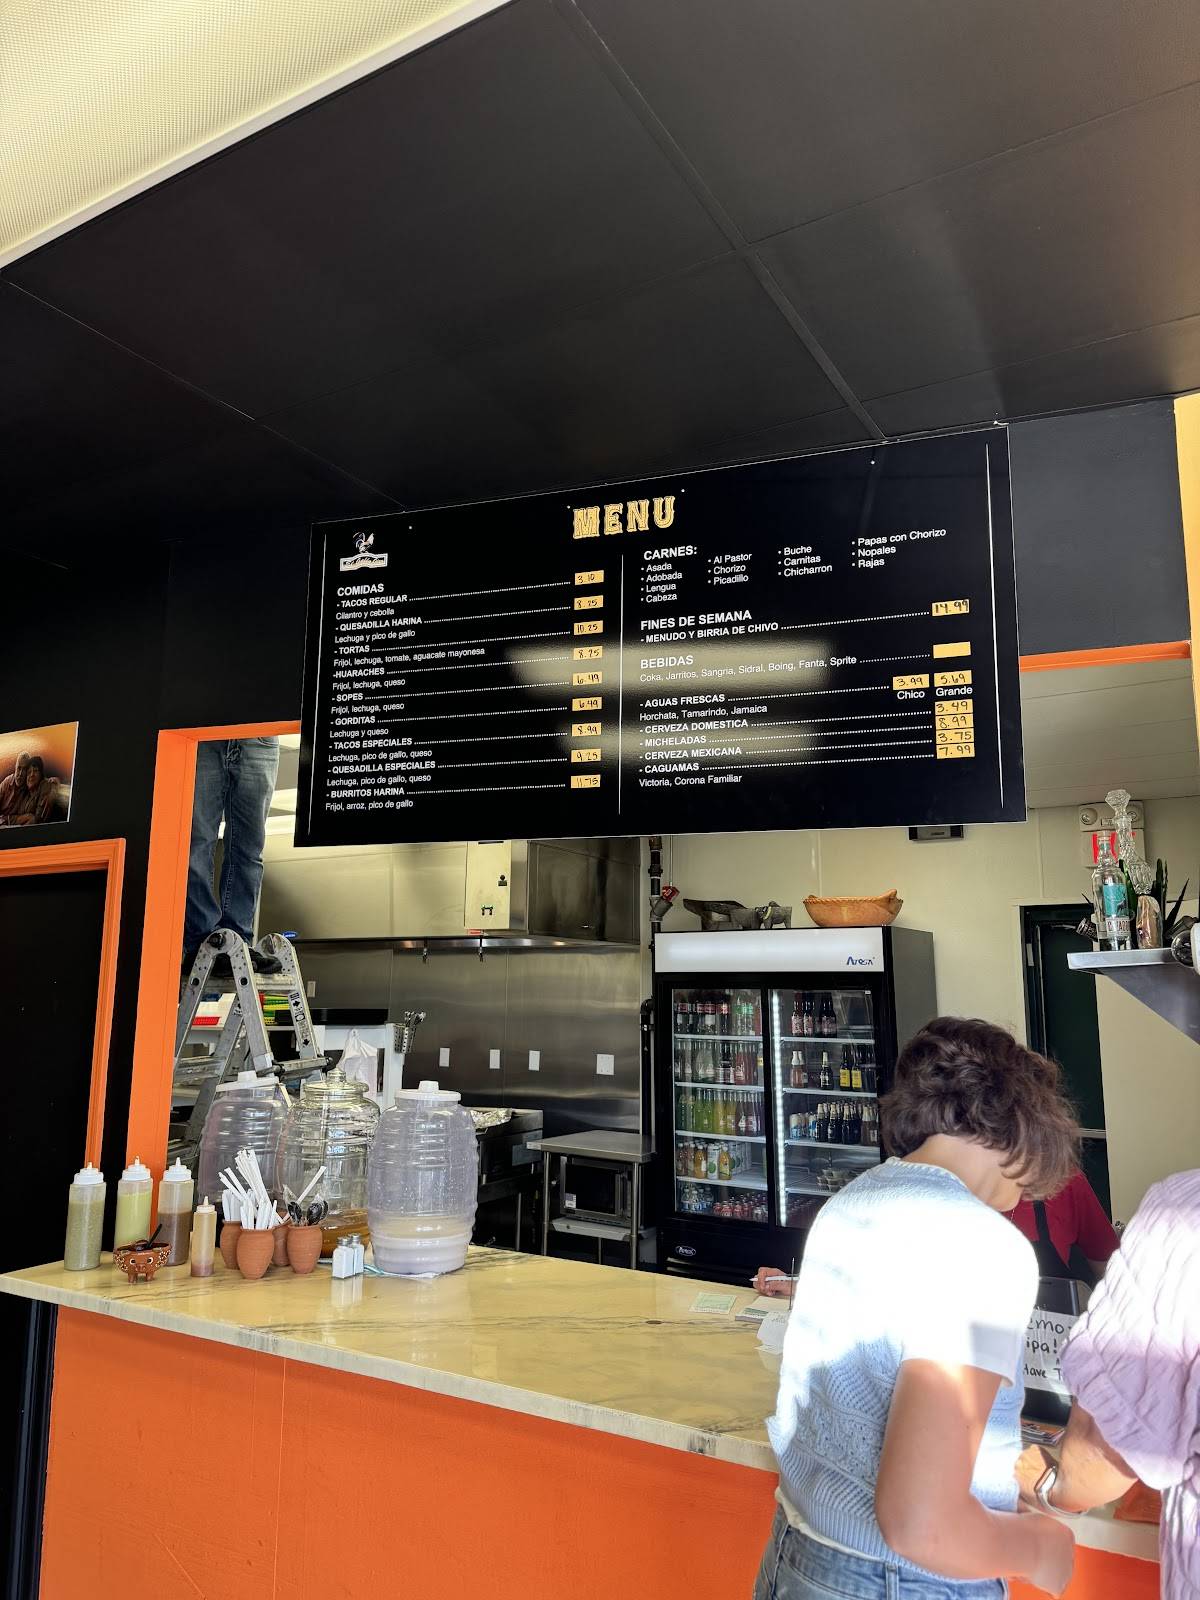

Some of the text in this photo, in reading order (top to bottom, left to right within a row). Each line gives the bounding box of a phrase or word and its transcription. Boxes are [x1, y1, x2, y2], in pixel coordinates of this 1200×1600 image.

[573, 496, 675, 539] MENU
[858, 528, 946, 547] Papas con Chorizo
[644, 545, 697, 560] CARNES:
[784, 546, 812, 556] Buche
[858, 546, 896, 557] Nopales
[714, 553, 752, 564] Al Pastor
[784, 555, 821, 566] Carnitas
[858, 558, 884, 568] Rajas
[646, 562, 672, 572] Asada
[713, 565, 746, 574] Chorizo
[784, 564, 832, 576] Chicharron
[646, 572, 682, 582] Adobada
[714, 574, 748, 585] Picadillo
[337, 583, 384, 596] COMIDAS
[646, 583, 676, 593] Lengua
[342, 594, 408, 608] TACOS REGULAR
[646, 592, 677, 602] Cabeza
[935, 600, 969, 614] 14.99
[336, 610, 362, 620] Cilantro
[364, 610, 368, 618] y
[641, 610, 752, 630] FINES DE SEMANA
[340, 617, 422, 631] QUESADILLA HARINA
[335, 630, 415, 644] Lechuga y pico de gallo
[646, 632, 686, 643] MENUDO
[698, 628, 729, 638] BIRRIA
[732, 626, 745, 634] DE
[748, 622, 778, 632] CHIVO
[339, 645, 370, 654] TORTAS
[640, 655, 693, 669] BEBIDAS
[640, 656, 856, 682] Coka, Jarritos, Sangria, Sidral, Boing, Fanta, Sprite
[896, 677, 922, 686] 3.99
[897, 690, 925, 700] Chico
[936, 686, 972, 696] Grande
[336, 693, 363, 701] SOPES
[645, 694, 725, 708] AGUAS FRESCAS
[640, 705, 767, 721] Horchata, Tamarindo, Jamaica
[335, 716, 375, 726] GORDITAS
[645, 719, 748, 734] CERVEZA DOMESTICA
[330, 728, 388, 738] Lechuga y queso
[938, 731, 972, 742] 3.75
[334, 738, 412, 749] TACOS ESPECIALES
[645, 736, 706, 747] MICHELADAS
[645, 747, 742, 760] CERVEZA MEXICANA
[939, 745, 971, 756] 7.99
[332, 761, 436, 774] QUESADILLA ESPECIALES
[645, 763, 699, 774] CAGUAMAS
[639, 774, 742, 787] Victoria, Corona Familiar
[331, 787, 404, 798] BURRITOS HARINA
